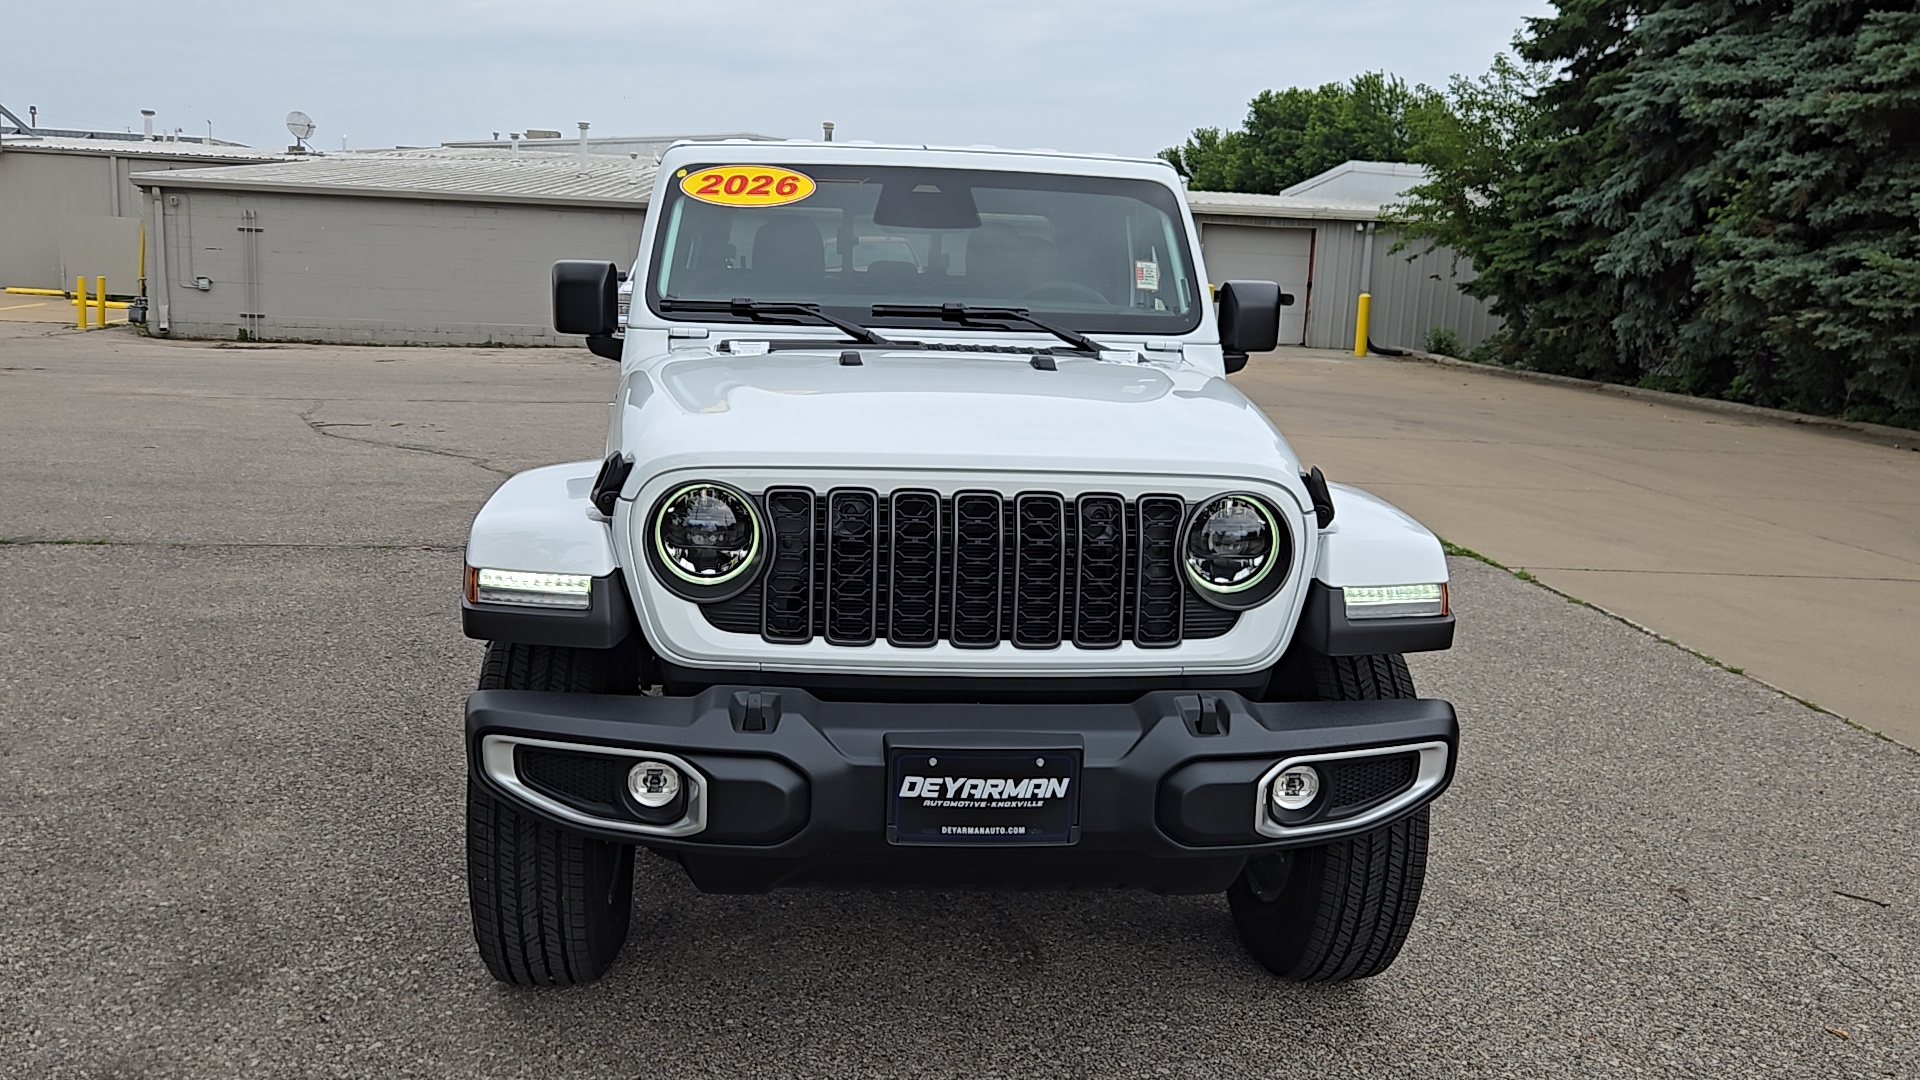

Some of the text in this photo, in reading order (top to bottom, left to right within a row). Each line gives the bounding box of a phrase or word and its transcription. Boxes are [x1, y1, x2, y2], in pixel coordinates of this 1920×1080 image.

[695, 174, 801, 196] 2026
[899, 776, 1071, 799] DEYARMAN
[941, 826, 1026, 835] DEYARMANAUTO.COM
